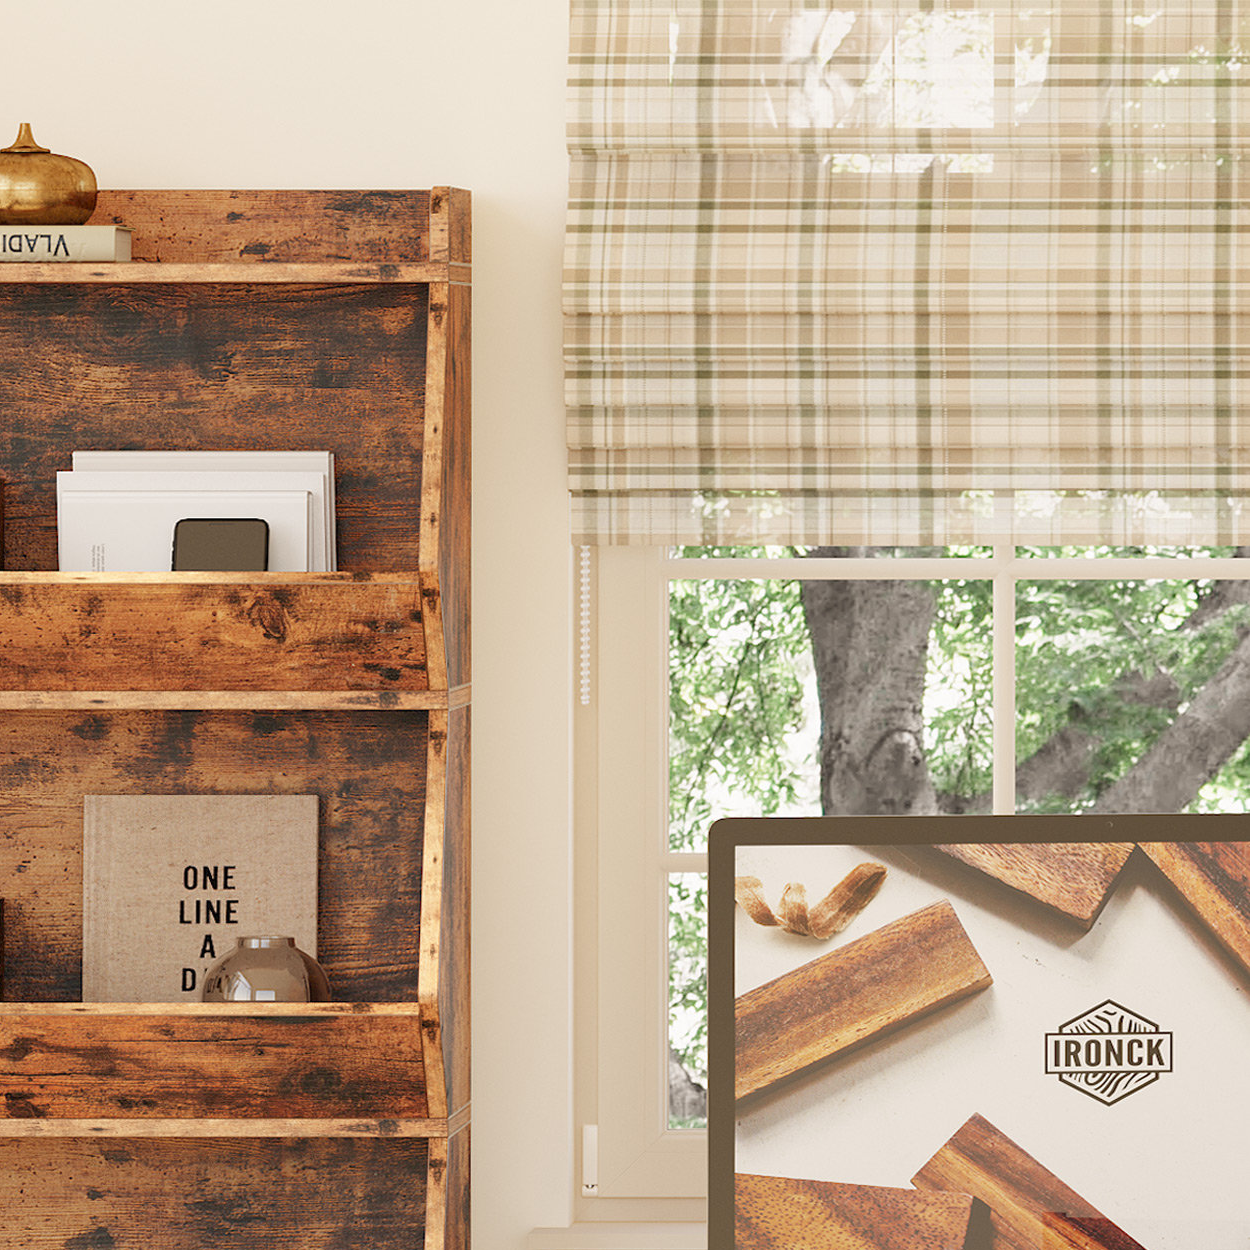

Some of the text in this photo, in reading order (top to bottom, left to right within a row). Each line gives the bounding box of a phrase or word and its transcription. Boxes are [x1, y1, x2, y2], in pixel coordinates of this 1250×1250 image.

[183, 865, 237, 890] ONE
[179, 899, 240, 924] LINE
[199, 934, 217, 958] A
[1053, 1038, 1165, 1067] IRONCK
